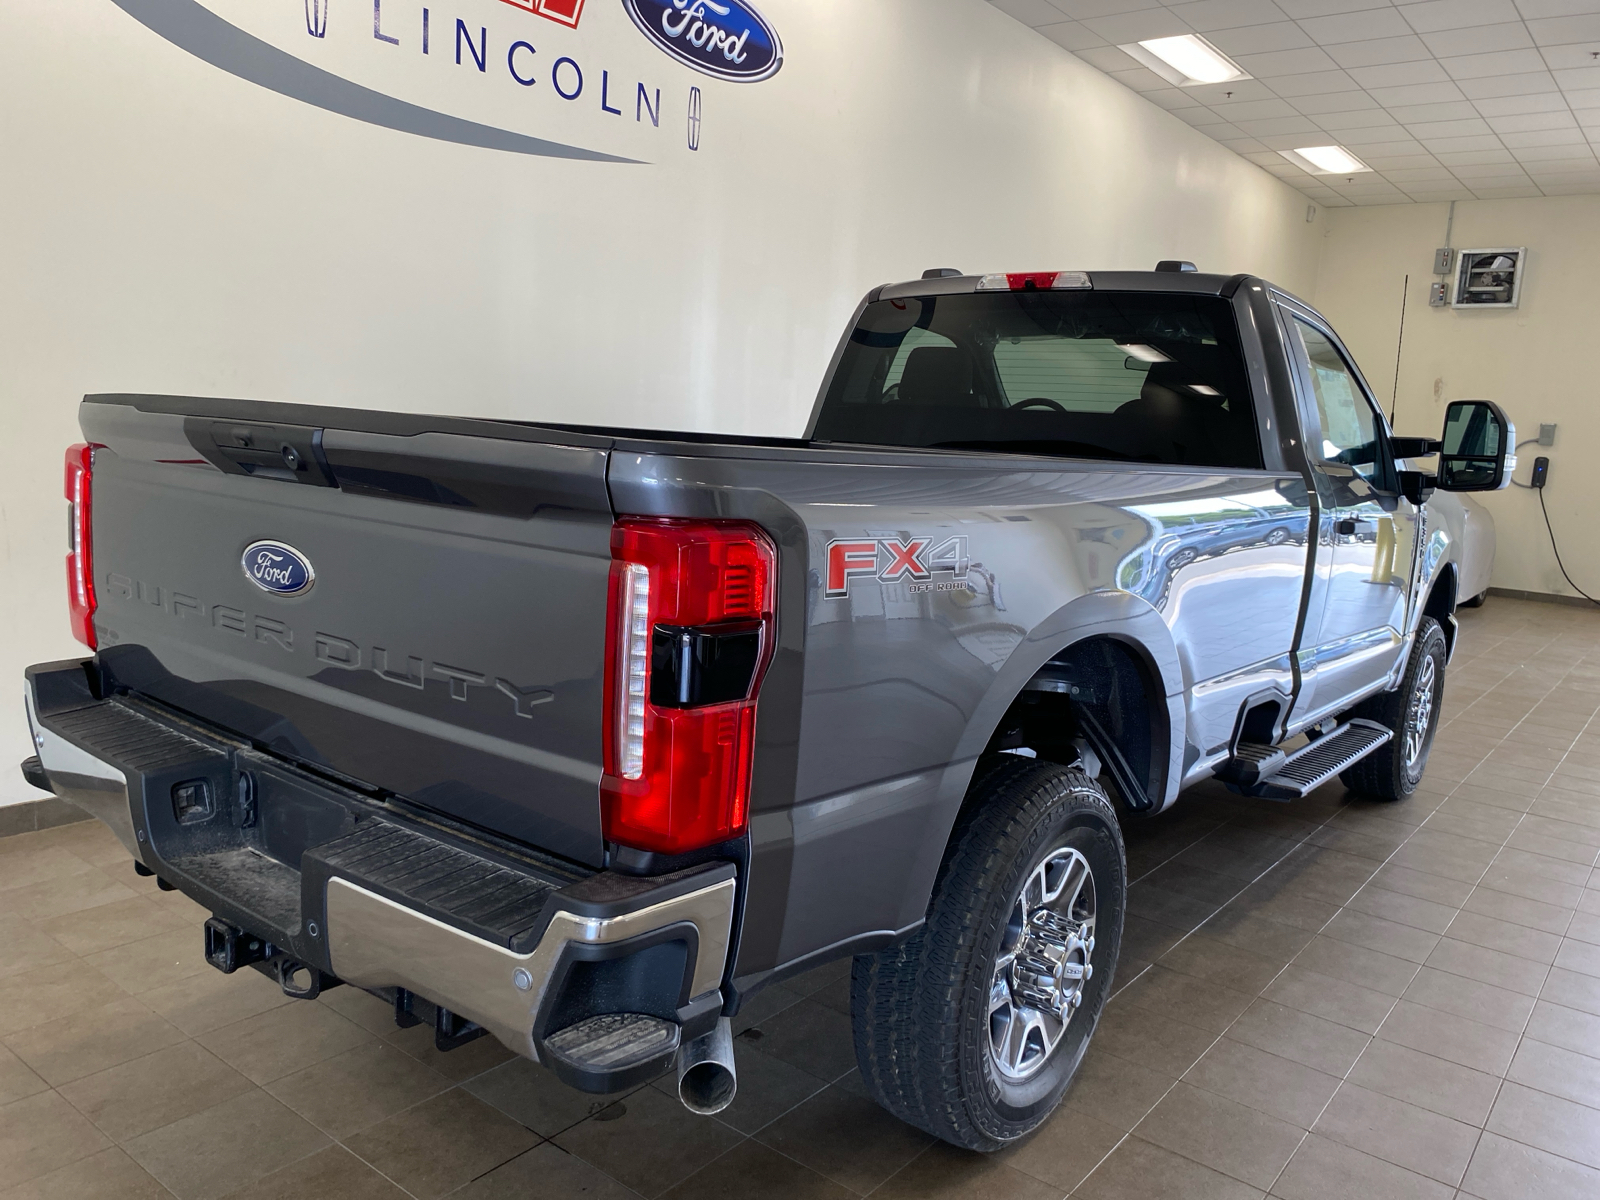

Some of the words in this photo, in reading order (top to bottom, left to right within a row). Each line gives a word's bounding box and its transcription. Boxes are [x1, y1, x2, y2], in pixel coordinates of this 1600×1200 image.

[373, 0, 661, 127] LINCOLN
[661, 0, 748, 64] Ford
[254, 551, 293, 585] Ford
[824, 535, 970, 600] FX4
[909, 583, 934, 593] OFF
[937, 581, 968, 592] ROAD
[106, 571, 295, 652] SUPER
[315, 630, 555, 719] DUTY
